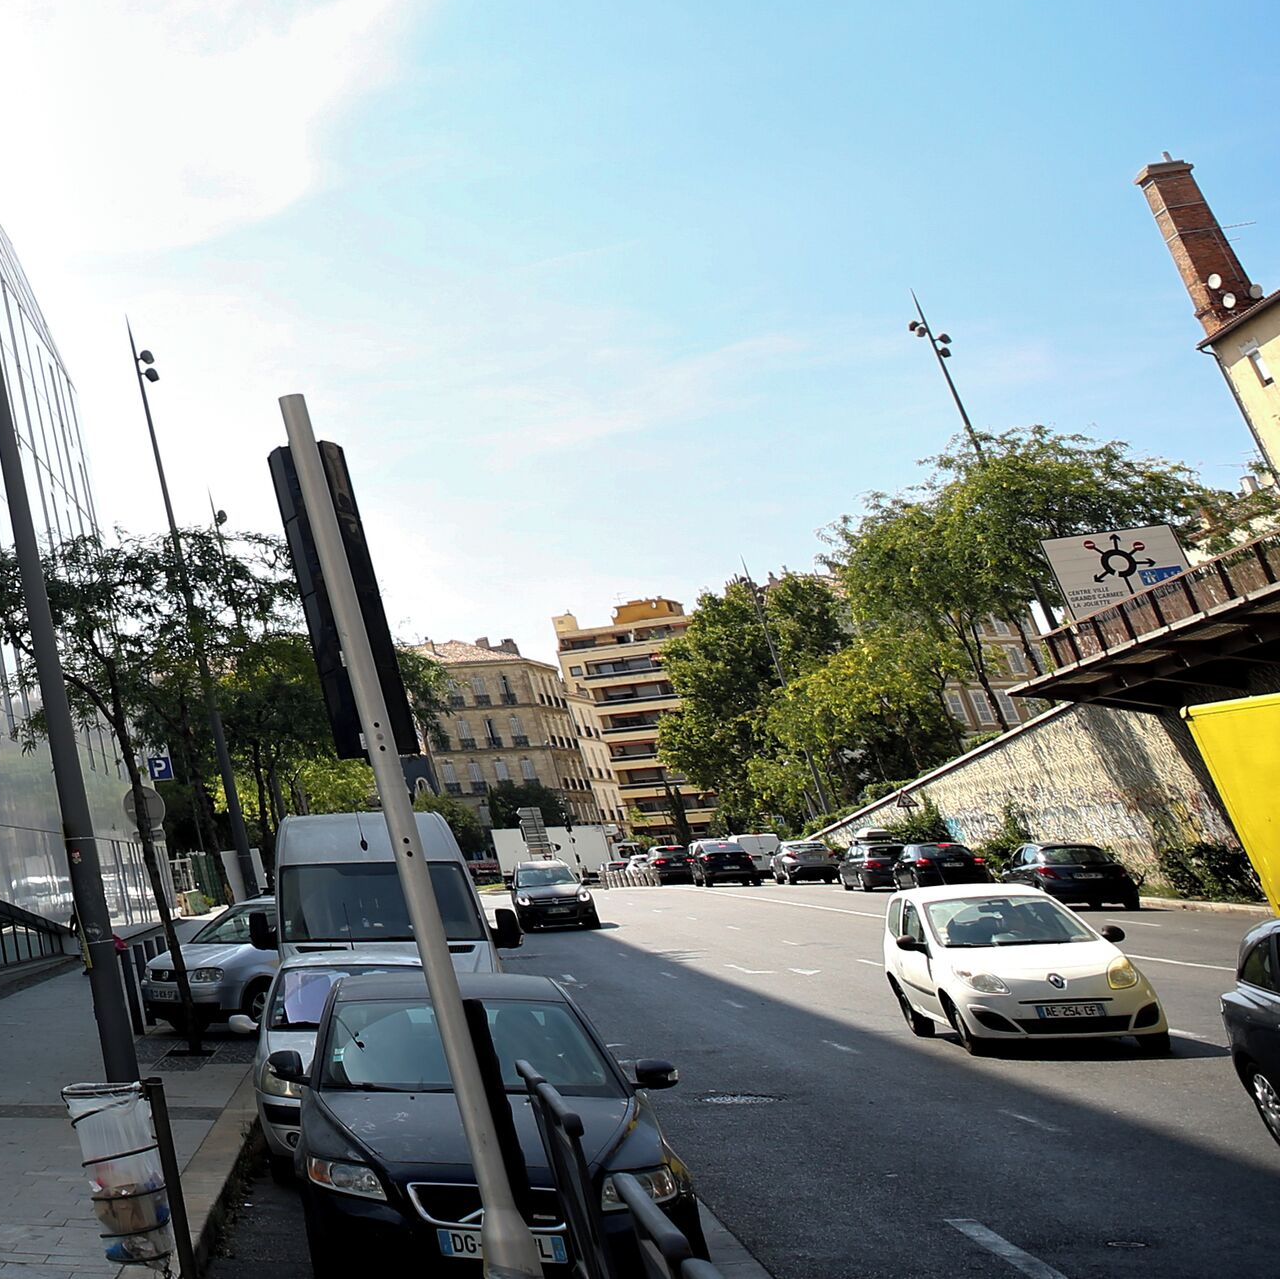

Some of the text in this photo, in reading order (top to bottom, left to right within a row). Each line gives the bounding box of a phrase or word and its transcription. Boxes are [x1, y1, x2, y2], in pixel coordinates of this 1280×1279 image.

[1067, 586, 1110, 597] CENTRE VILLE
[1070, 591, 1124, 602] GRANDS CARMES
[1083, 599, 1111, 607] JOLIETTE
[154, 760, 167, 777] P
